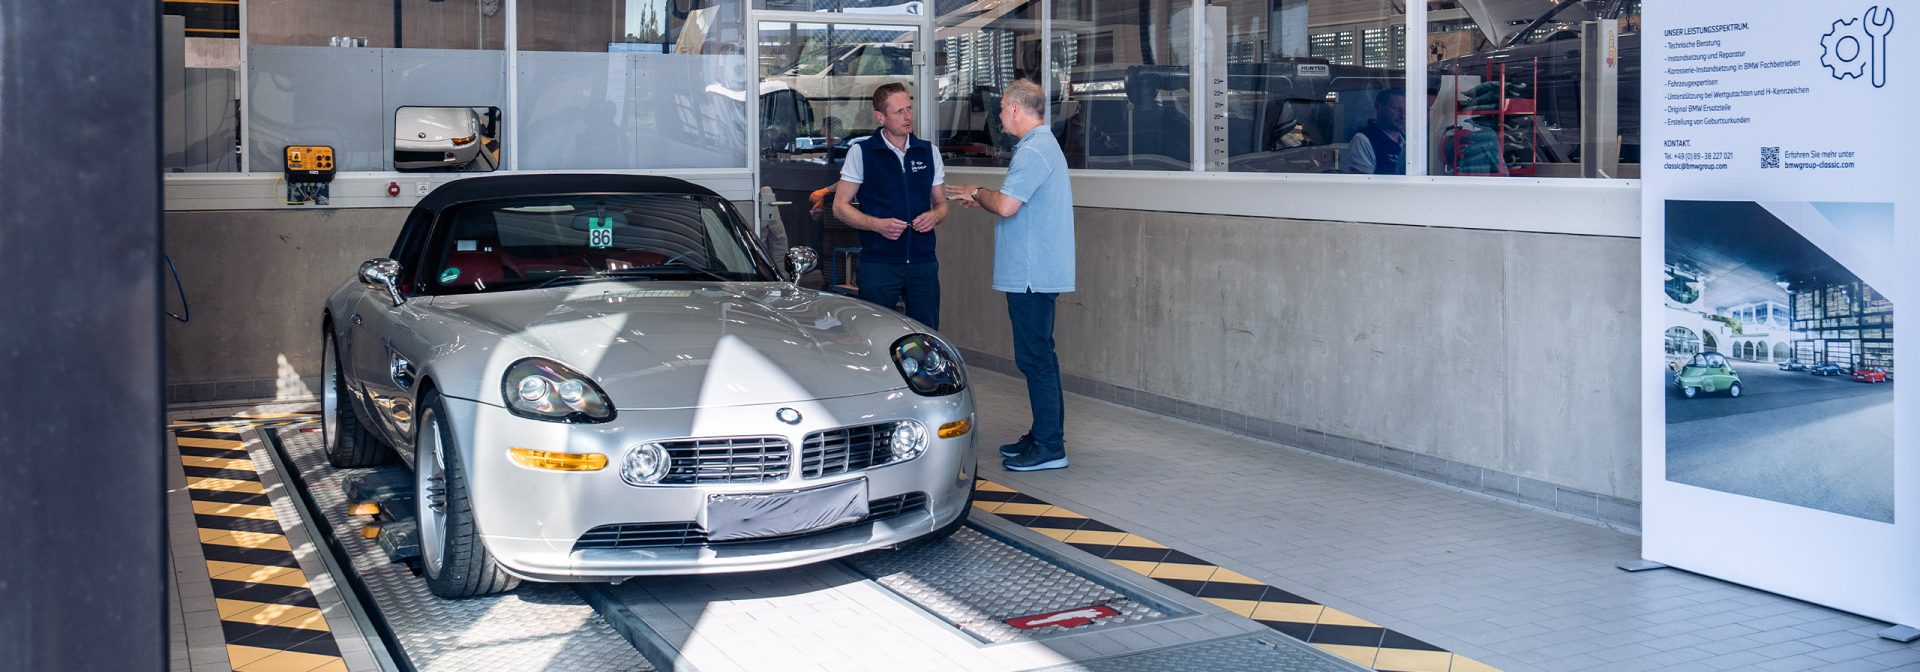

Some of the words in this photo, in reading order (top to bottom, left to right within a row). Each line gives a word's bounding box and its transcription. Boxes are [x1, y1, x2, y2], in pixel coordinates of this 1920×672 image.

[1664, 28, 1684, 37] UNSER
[1684, 22, 1749, 36] LEISTUNGSSPEKTRUM.
[1668, 41, 1695, 49] Technische
[1696, 39, 1721, 48] Beratung
[1668, 53, 1707, 62] Instandsetzung
[1708, 51, 1718, 59] und
[1719, 50, 1746, 59] Reparatur
[1744, 61, 1760, 70] BMW
[1760, 59, 1801, 69] Fachbetrieben
[1668, 79, 1718, 88] Fahrzeugexpertisen
[1705, 91, 1713, 99] bei
[1713, 89, 1753, 99] Wertgutachten
[1753, 88, 1765, 96] und
[1765, 86, 1810, 96] H-Kennzeichen
[1668, 105, 1688, 114] Original
[1688, 104, 1702, 112] BMW
[1703, 103, 1732, 112] Ersatzteile
[1668, 118, 1693, 126] Erstellung
[1704, 116, 1751, 125] Geburtsurkunden
[1664, 139, 1692, 148] KONTAKT.
[1712, 152, 1723, 160] 227
[1723, 151, 1734, 160] 021
[1784, 150, 1810, 159] Erfahren
[1810, 149, 1820, 158] Sie
[1821, 149, 1837, 158] mehr
[1838, 150, 1855, 158] unter
[1664, 162, 1728, 171] classic@bmwgroup.com
[1784, 160, 1855, 171] bmwgroup-classic.com
[591, 229, 611, 246] 86
